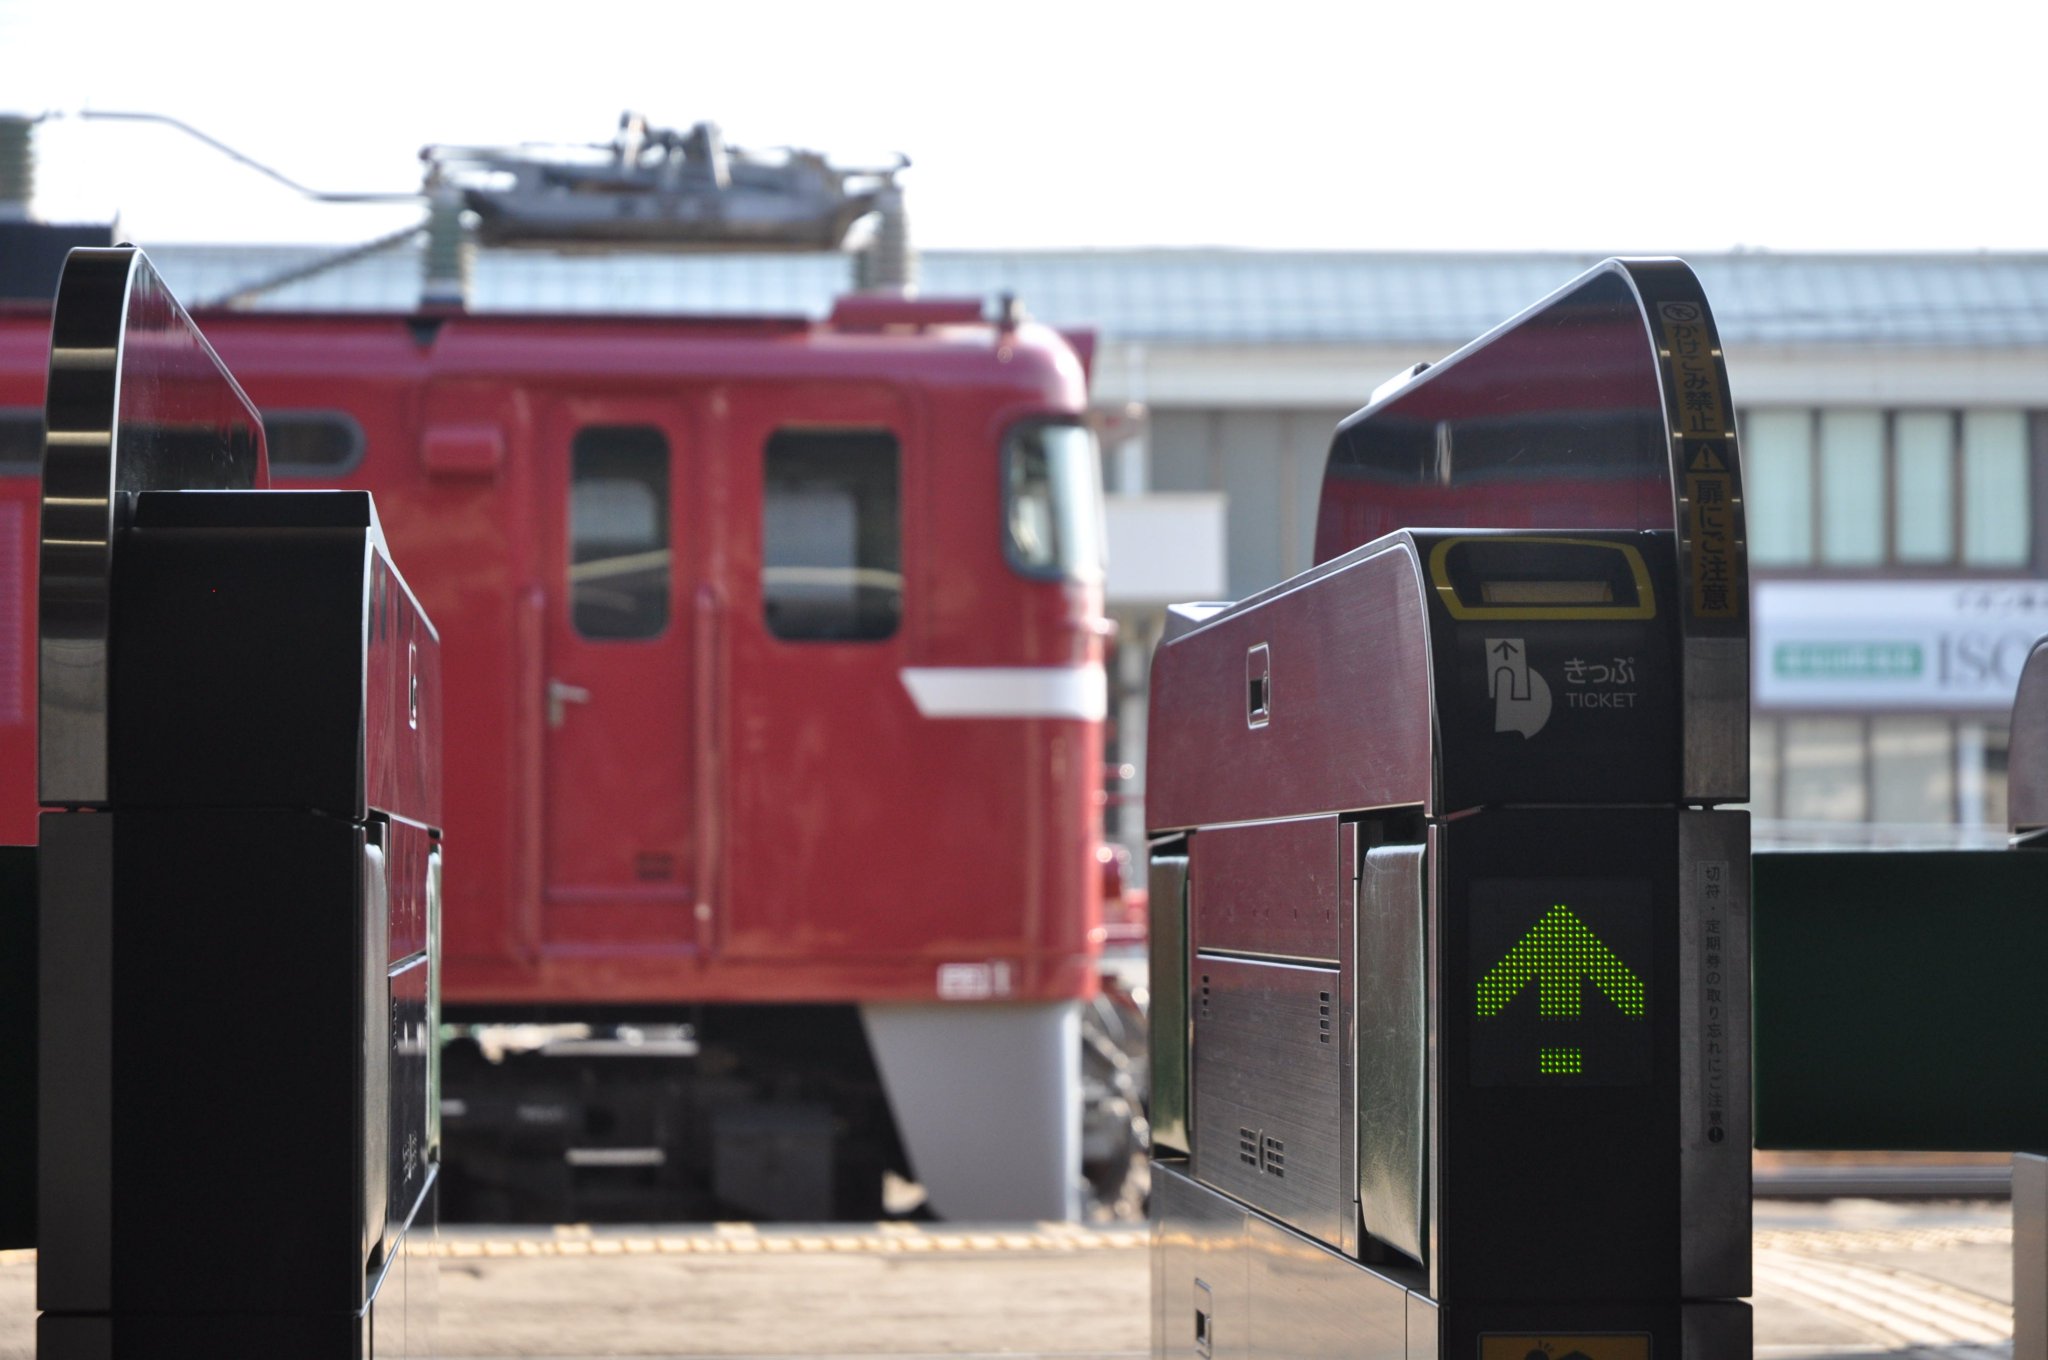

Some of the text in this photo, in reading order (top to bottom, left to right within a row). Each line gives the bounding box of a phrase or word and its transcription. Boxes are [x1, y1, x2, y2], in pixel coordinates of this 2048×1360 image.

[1672, 323, 1717, 433] かけこみ禁止
[1695, 480, 1729, 610] 扉にご注意
[1564, 657, 1636, 684] きっぷ
[1565, 692, 1637, 708] TICKET
